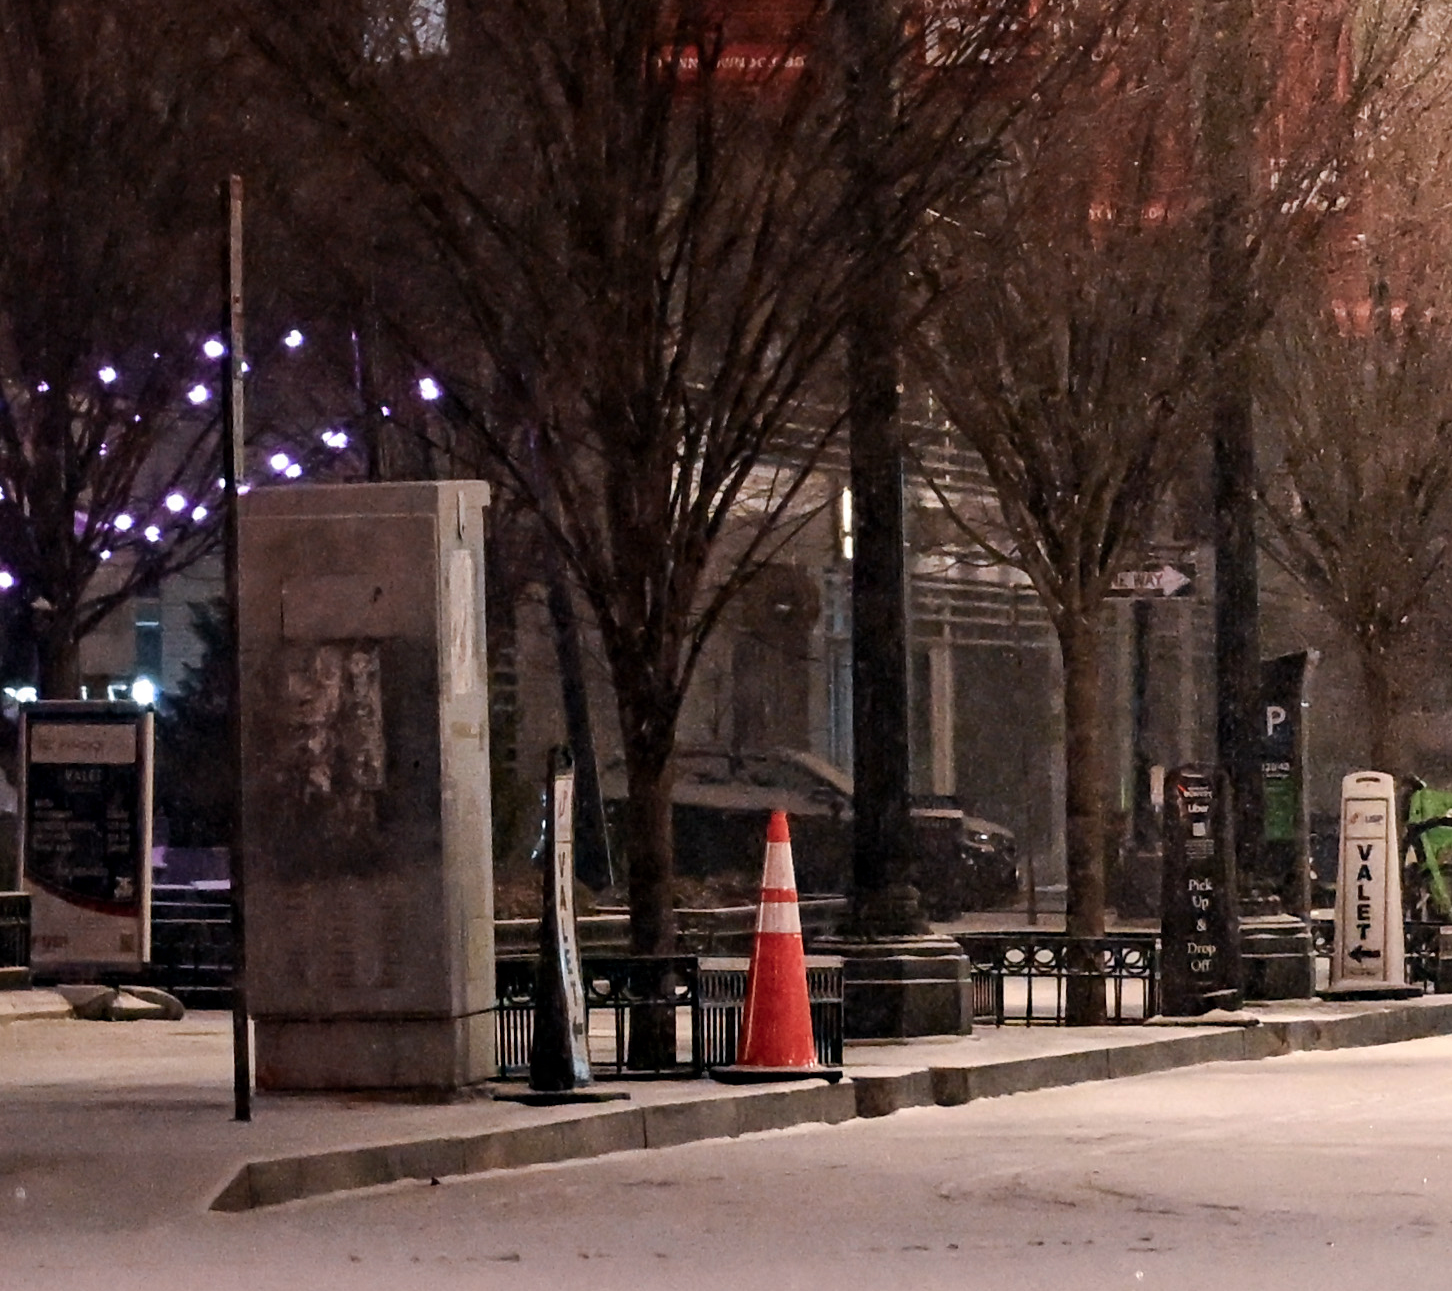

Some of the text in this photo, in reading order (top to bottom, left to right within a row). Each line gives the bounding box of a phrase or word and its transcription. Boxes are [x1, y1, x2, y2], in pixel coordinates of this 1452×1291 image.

[1266, 705, 1286, 737] P
[1188, 878, 1213, 891] Pick
[1357, 844, 1373, 940] VALET
[1192, 895, 1209, 910] Up
[557, 851, 580, 1007] VALET
[1196, 918, 1207, 931] &
[1187, 942, 1217, 957] Drop
[1191, 959, 1212, 972] Off
